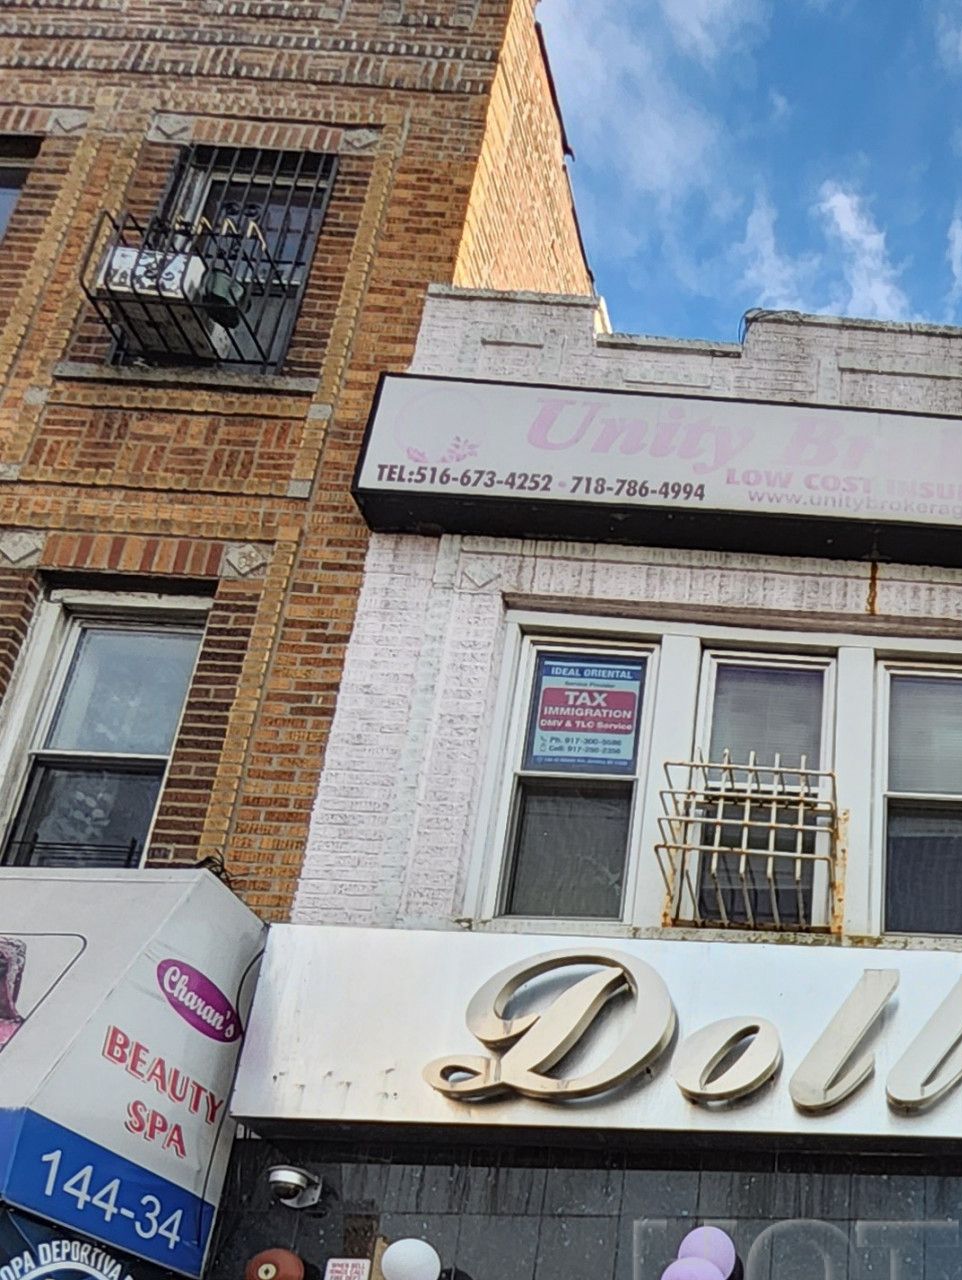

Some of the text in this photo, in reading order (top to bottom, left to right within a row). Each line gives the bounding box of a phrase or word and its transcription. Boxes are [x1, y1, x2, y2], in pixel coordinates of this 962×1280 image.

[526, 398, 757, 475] Unity
[377, 463, 706, 501] TEL:516-673-4252 718-786-4994
[725, 468, 794, 489] LOW
[803, 473, 872, 494] COST
[551, 667, 633, 679] IDEAL ORIENTAL
[543, 706, 632, 719] IMMIGRATION
[564, 691, 608, 707] TAX
[163, 965, 236, 1040] Charan's
[102, 1025, 226, 1125] BEAUTY
[124, 1099, 188, 1159] SPA
[41, 1149, 185, 1249] 144-34
